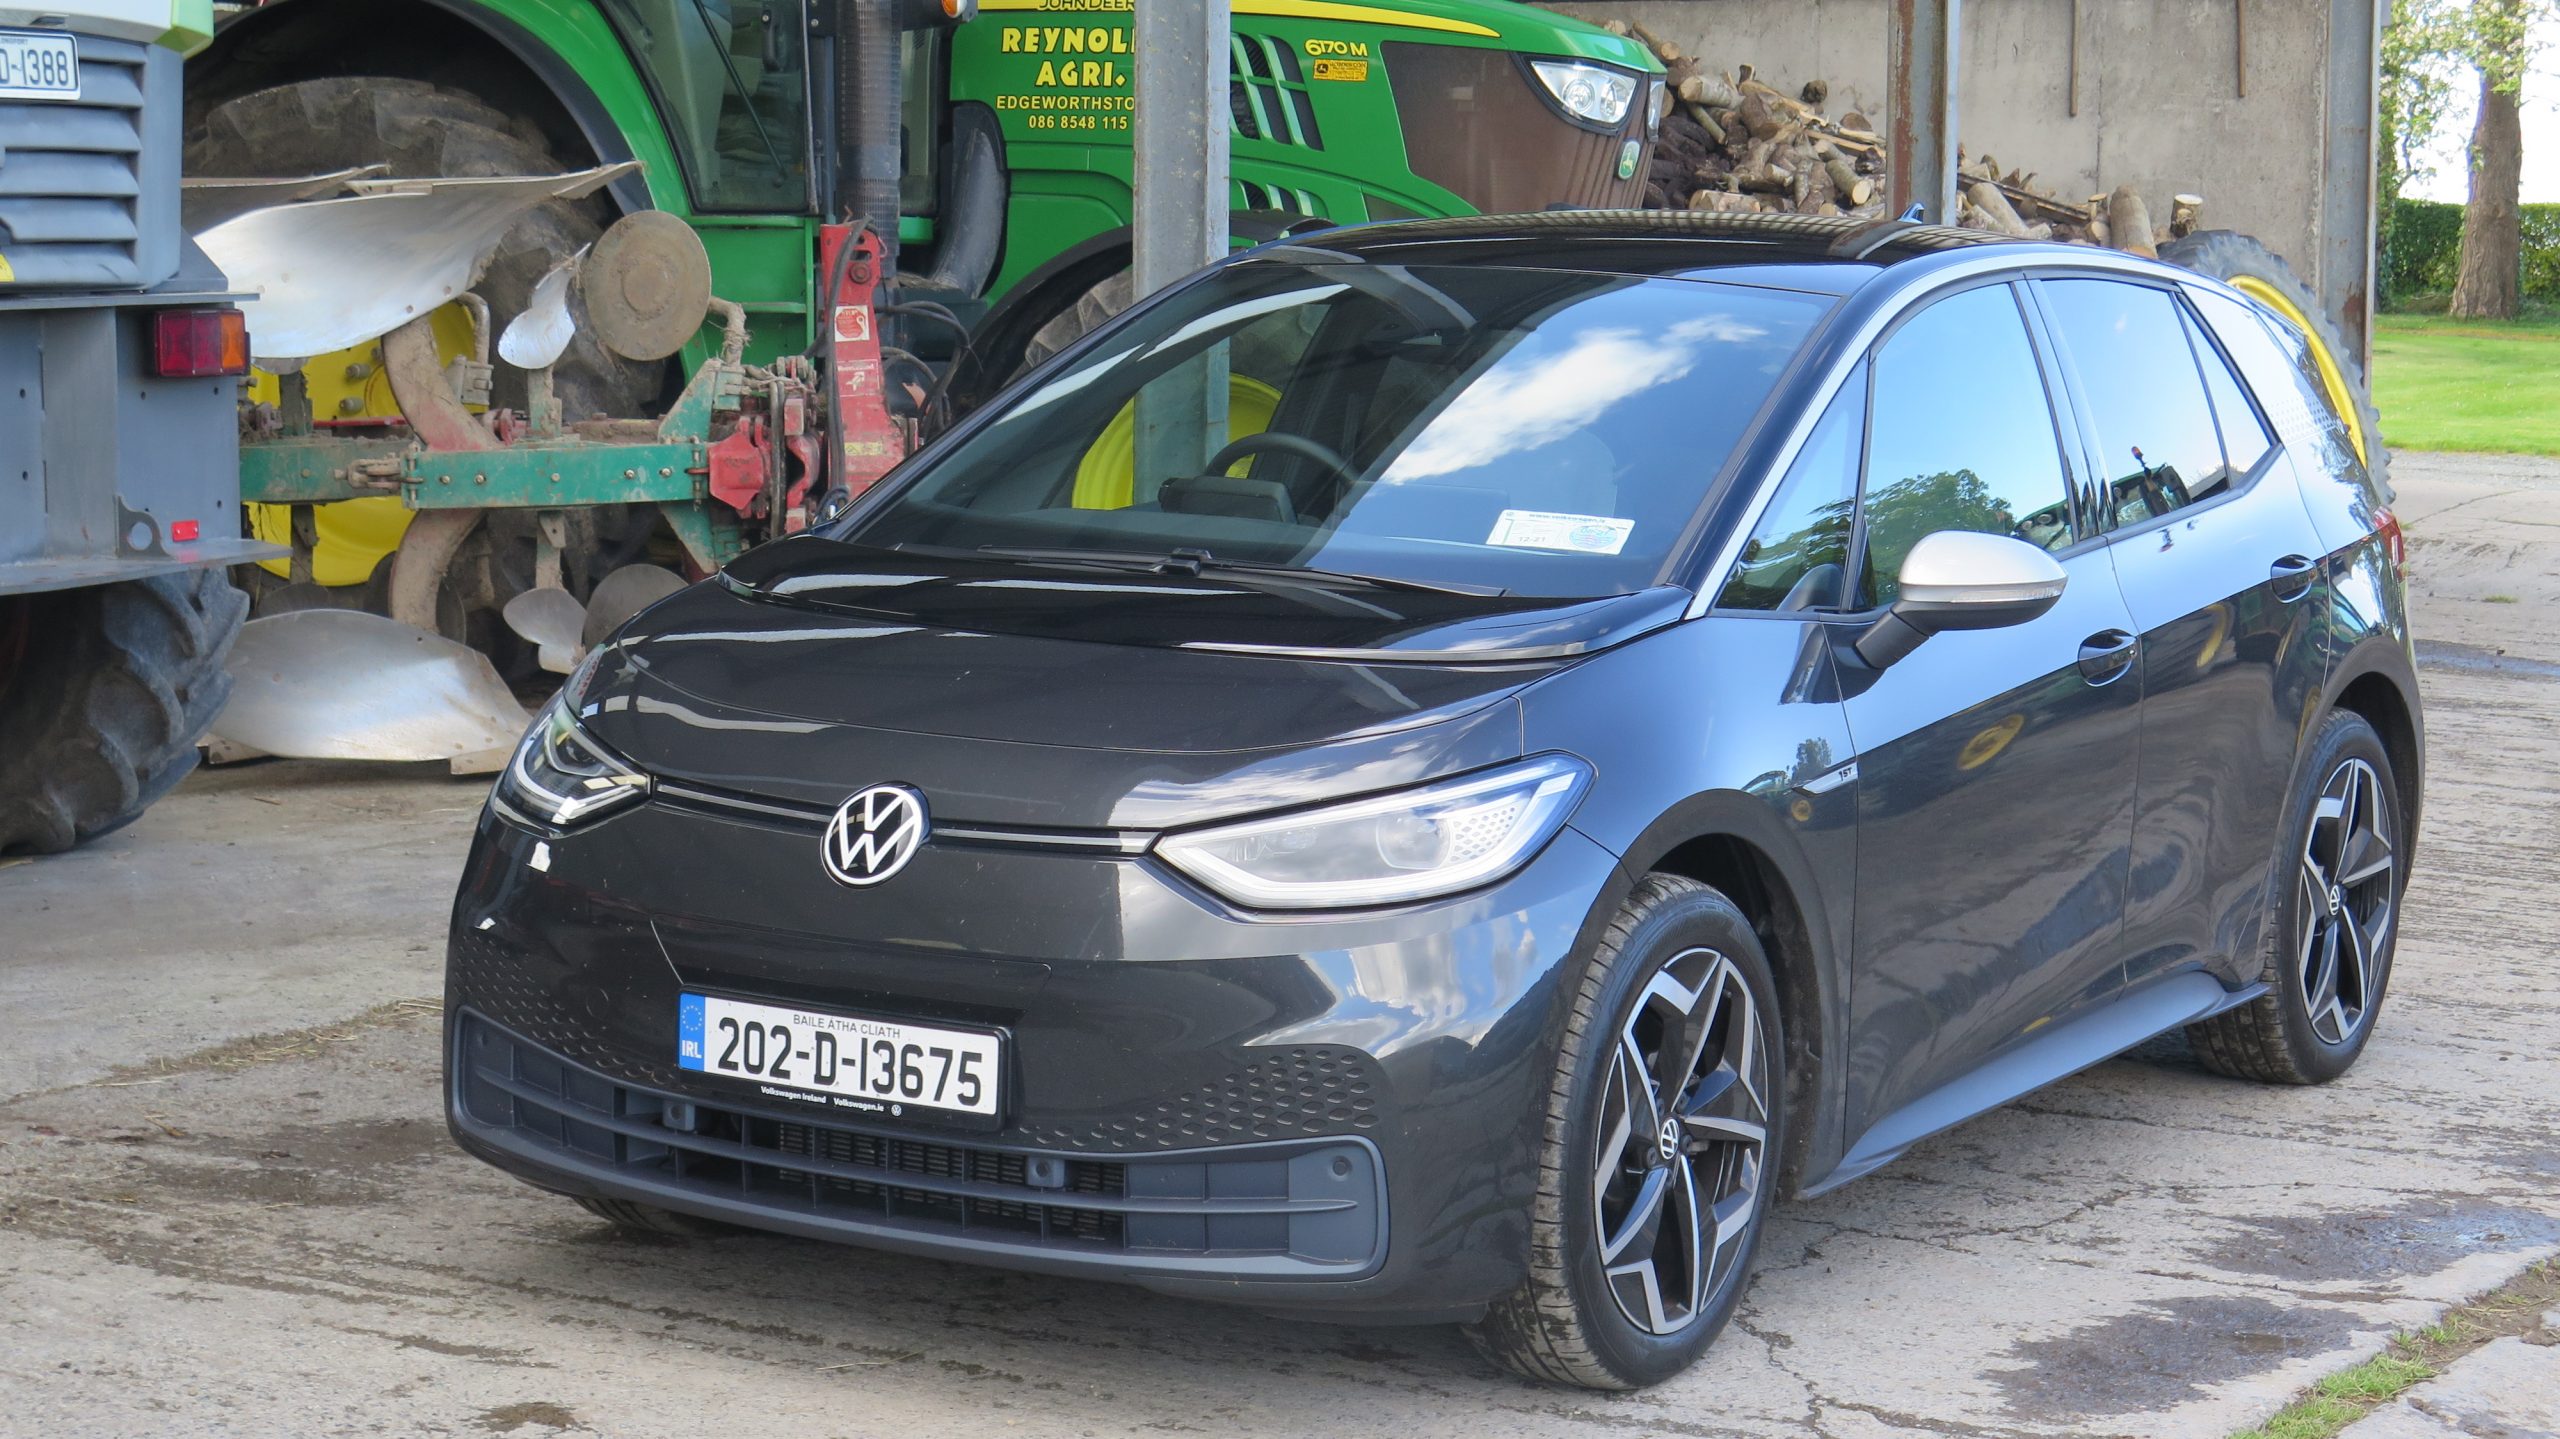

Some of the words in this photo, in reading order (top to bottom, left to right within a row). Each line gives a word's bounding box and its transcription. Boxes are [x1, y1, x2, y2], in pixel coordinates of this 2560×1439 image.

[1088, 0, 1135, 9] DEER
[1001, 27, 1135, 54] REYNOL
[1035, 60, 1126, 87] AGRI.
[996, 95, 1135, 110] EDGEWORTHSTO
[1028, 115, 1055, 129] 086
[1060, 115, 1096, 129] 8548
[1102, 115, 1128, 130] 115
[793, 1014, 824, 1028] BAILE
[827, 1016, 857, 1033] ÁTHA
[860, 1023, 901, 1038] CLIATH
[681, 1040, 702, 1059] IRL
[718, 1016, 983, 1107] 202-D-13675
[761, 1085, 801, 1100] Volkswagen
[802, 1092, 827, 1104] Ireland
[833, 1097, 885, 1112] Volkswagen.ie
